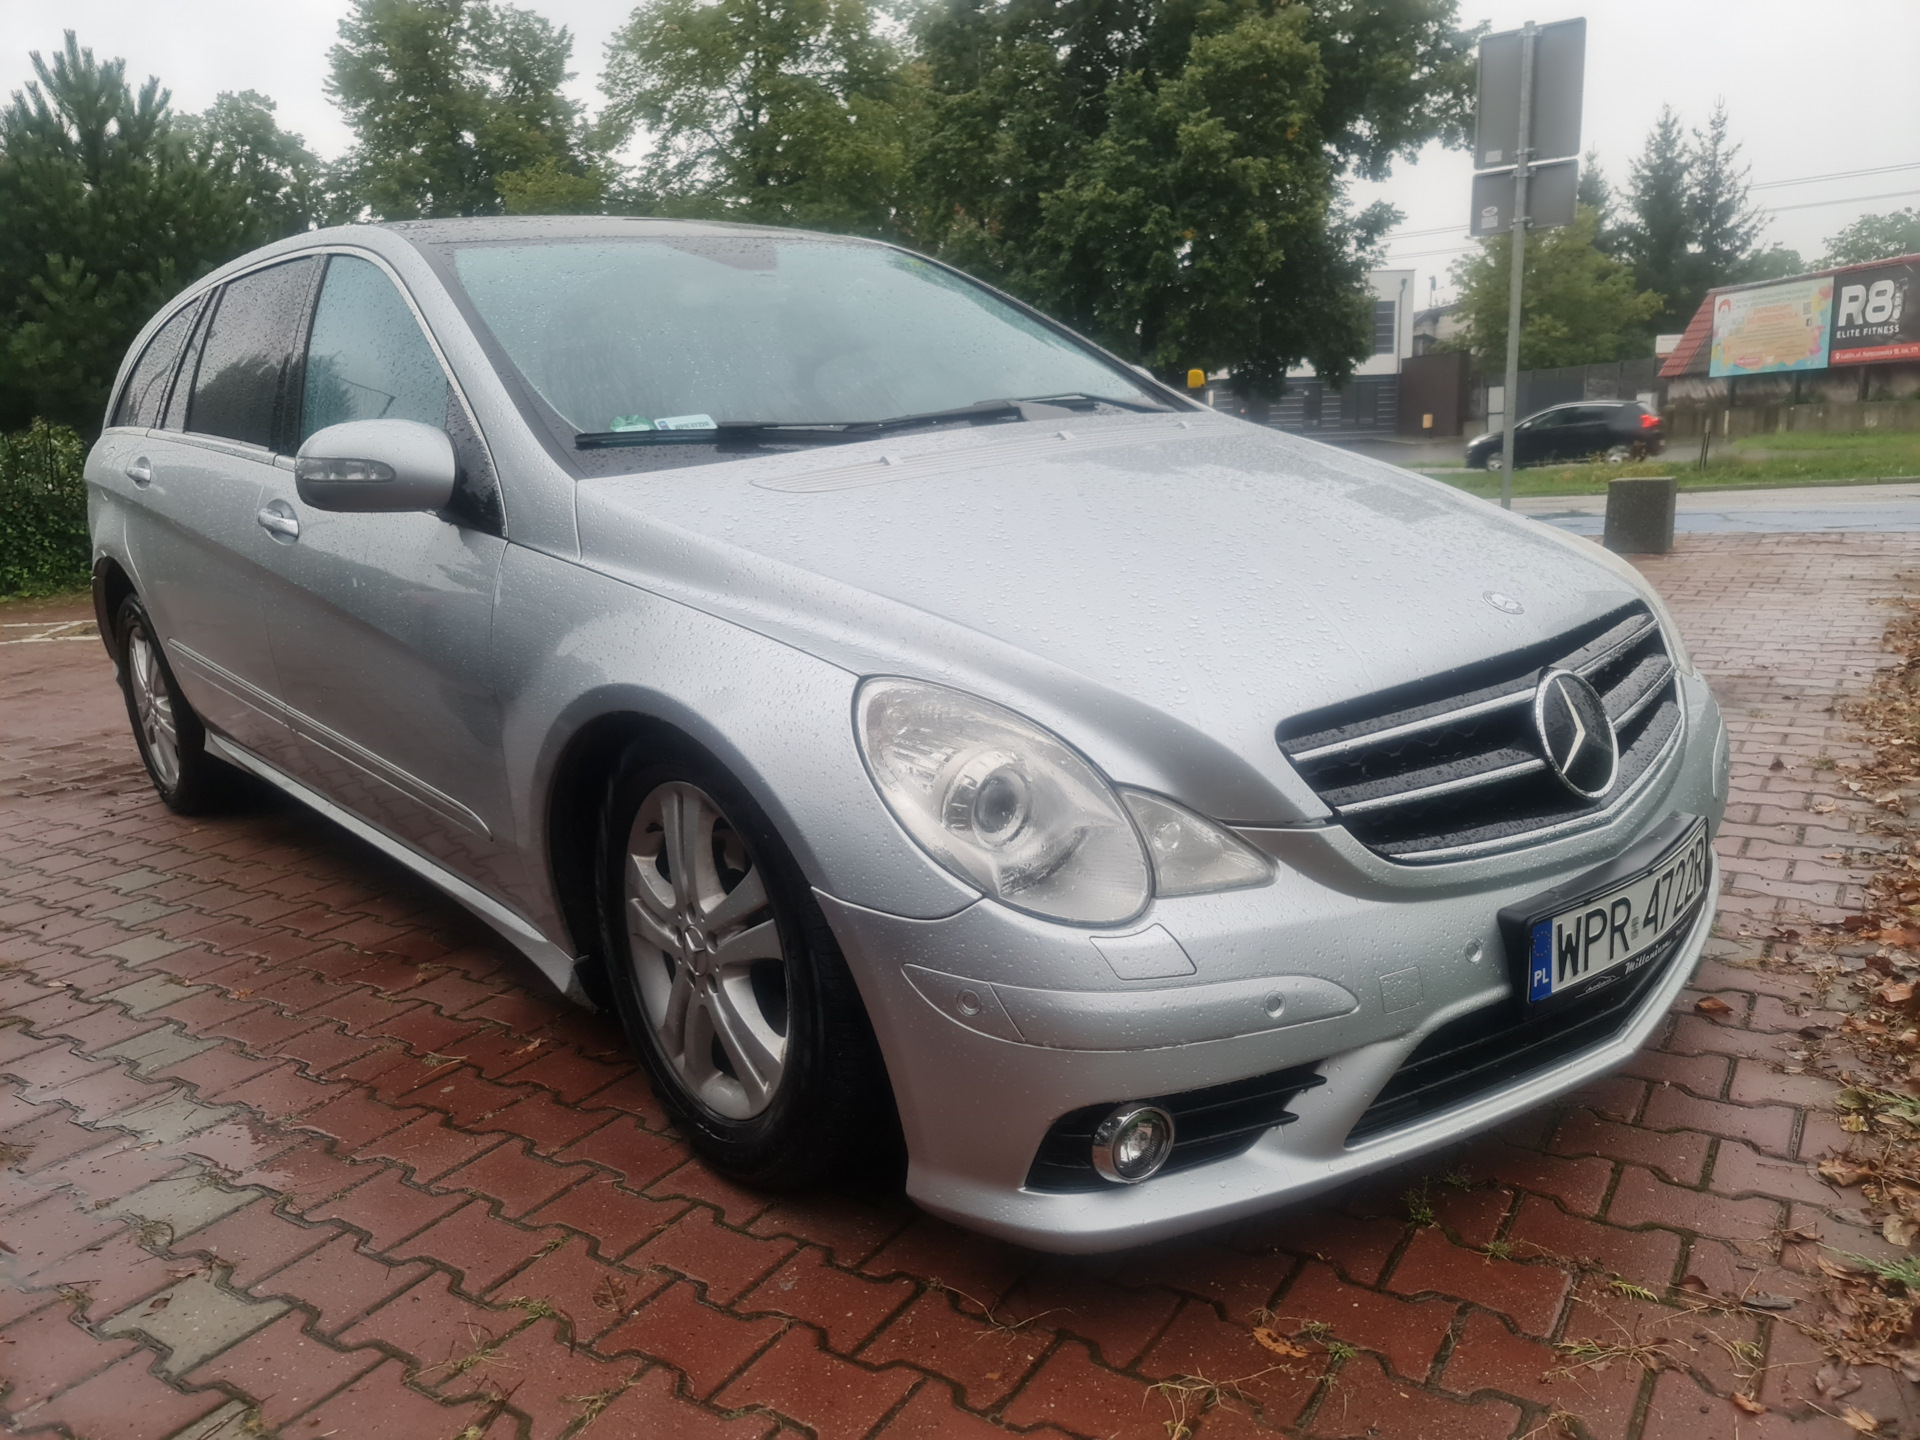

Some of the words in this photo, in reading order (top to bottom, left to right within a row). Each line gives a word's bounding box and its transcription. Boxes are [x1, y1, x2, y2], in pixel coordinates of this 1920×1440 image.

[1838, 280, 1894, 327] R8
[1836, 329, 1860, 338] ELITE
[1863, 325, 1900, 335] FITNESS
[1557, 897, 1631, 983] WPR
[1643, 836, 1704, 935] 4722R
[1534, 967, 1549, 988] PL
